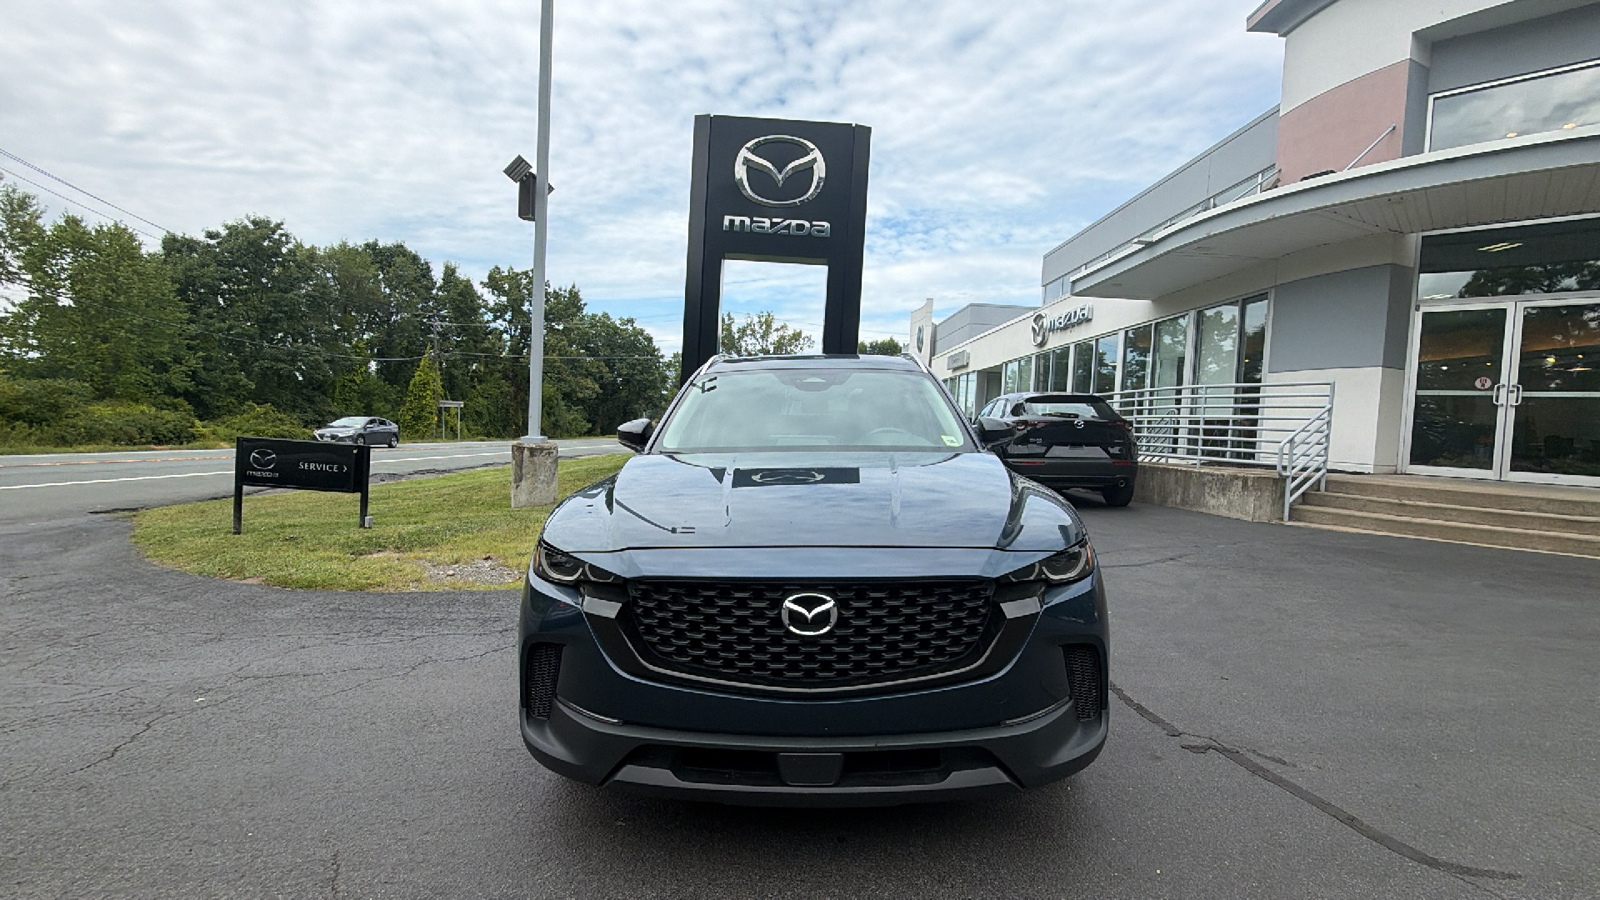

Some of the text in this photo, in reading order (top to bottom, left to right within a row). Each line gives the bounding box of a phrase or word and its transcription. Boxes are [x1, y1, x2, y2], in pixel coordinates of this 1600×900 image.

[723, 215, 831, 238] mazda
[1047, 304, 1092, 331] mazda
[298, 461, 339, 472] SERVICE
